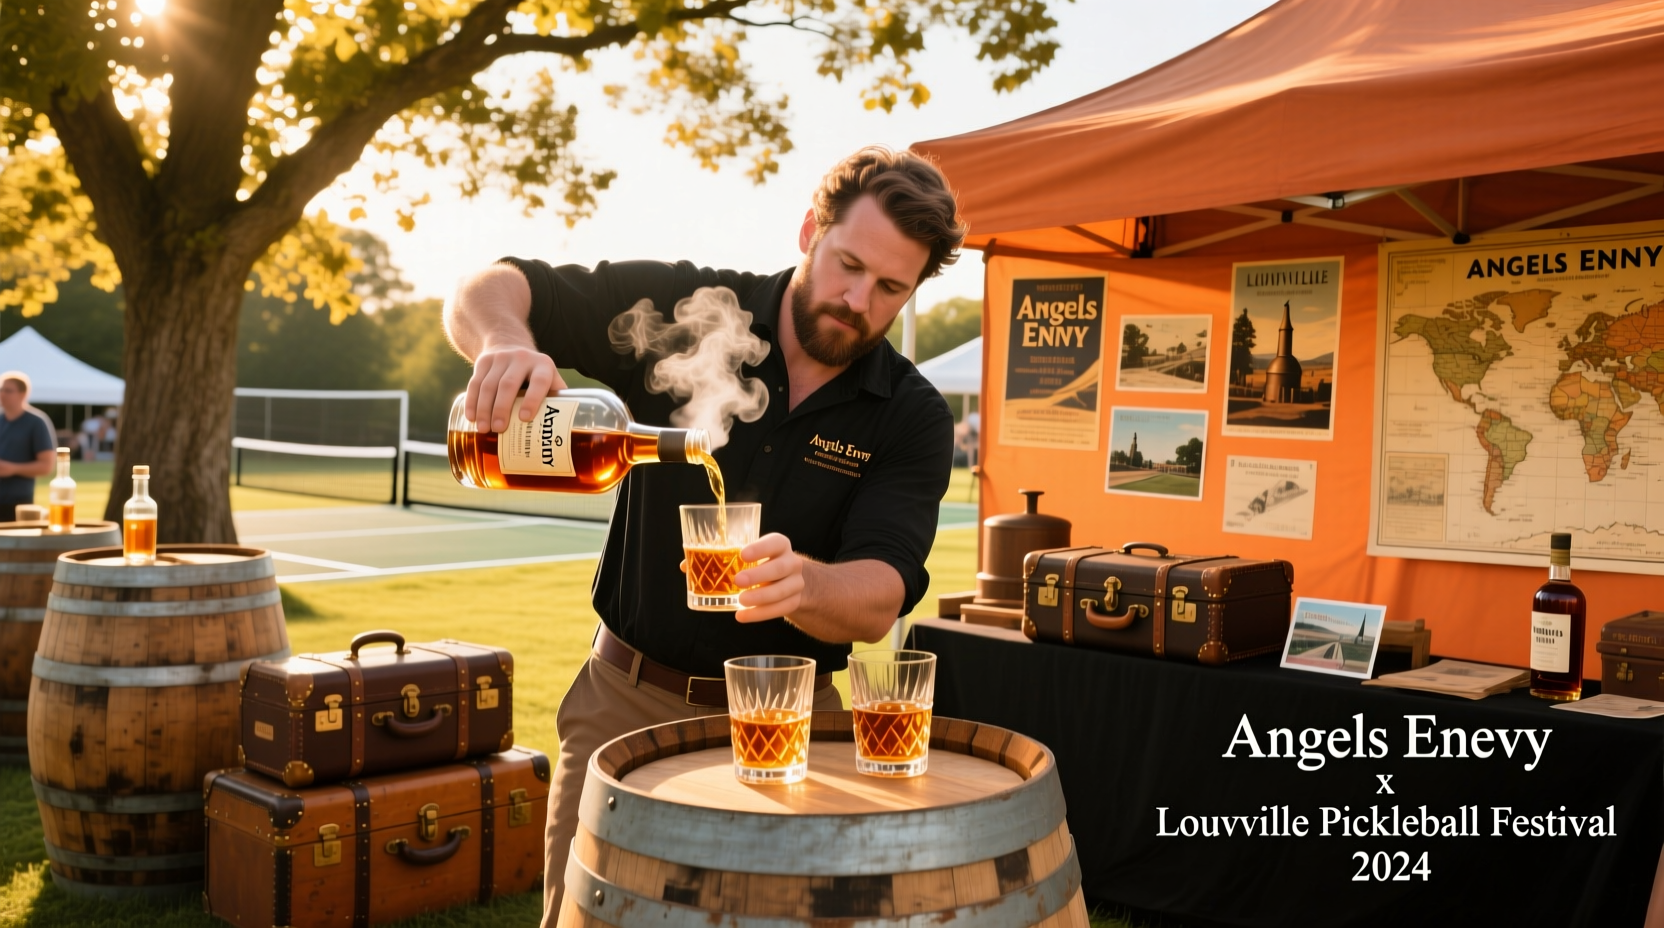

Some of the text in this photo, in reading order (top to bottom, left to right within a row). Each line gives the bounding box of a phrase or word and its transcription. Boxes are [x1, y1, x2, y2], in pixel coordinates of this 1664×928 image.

[1466, 252, 1568, 279] ANGELS
[1580, 245, 1664, 272] ENNY
[1016, 294, 1097, 326] Angels
[1022, 321, 1089, 348] ENNY
